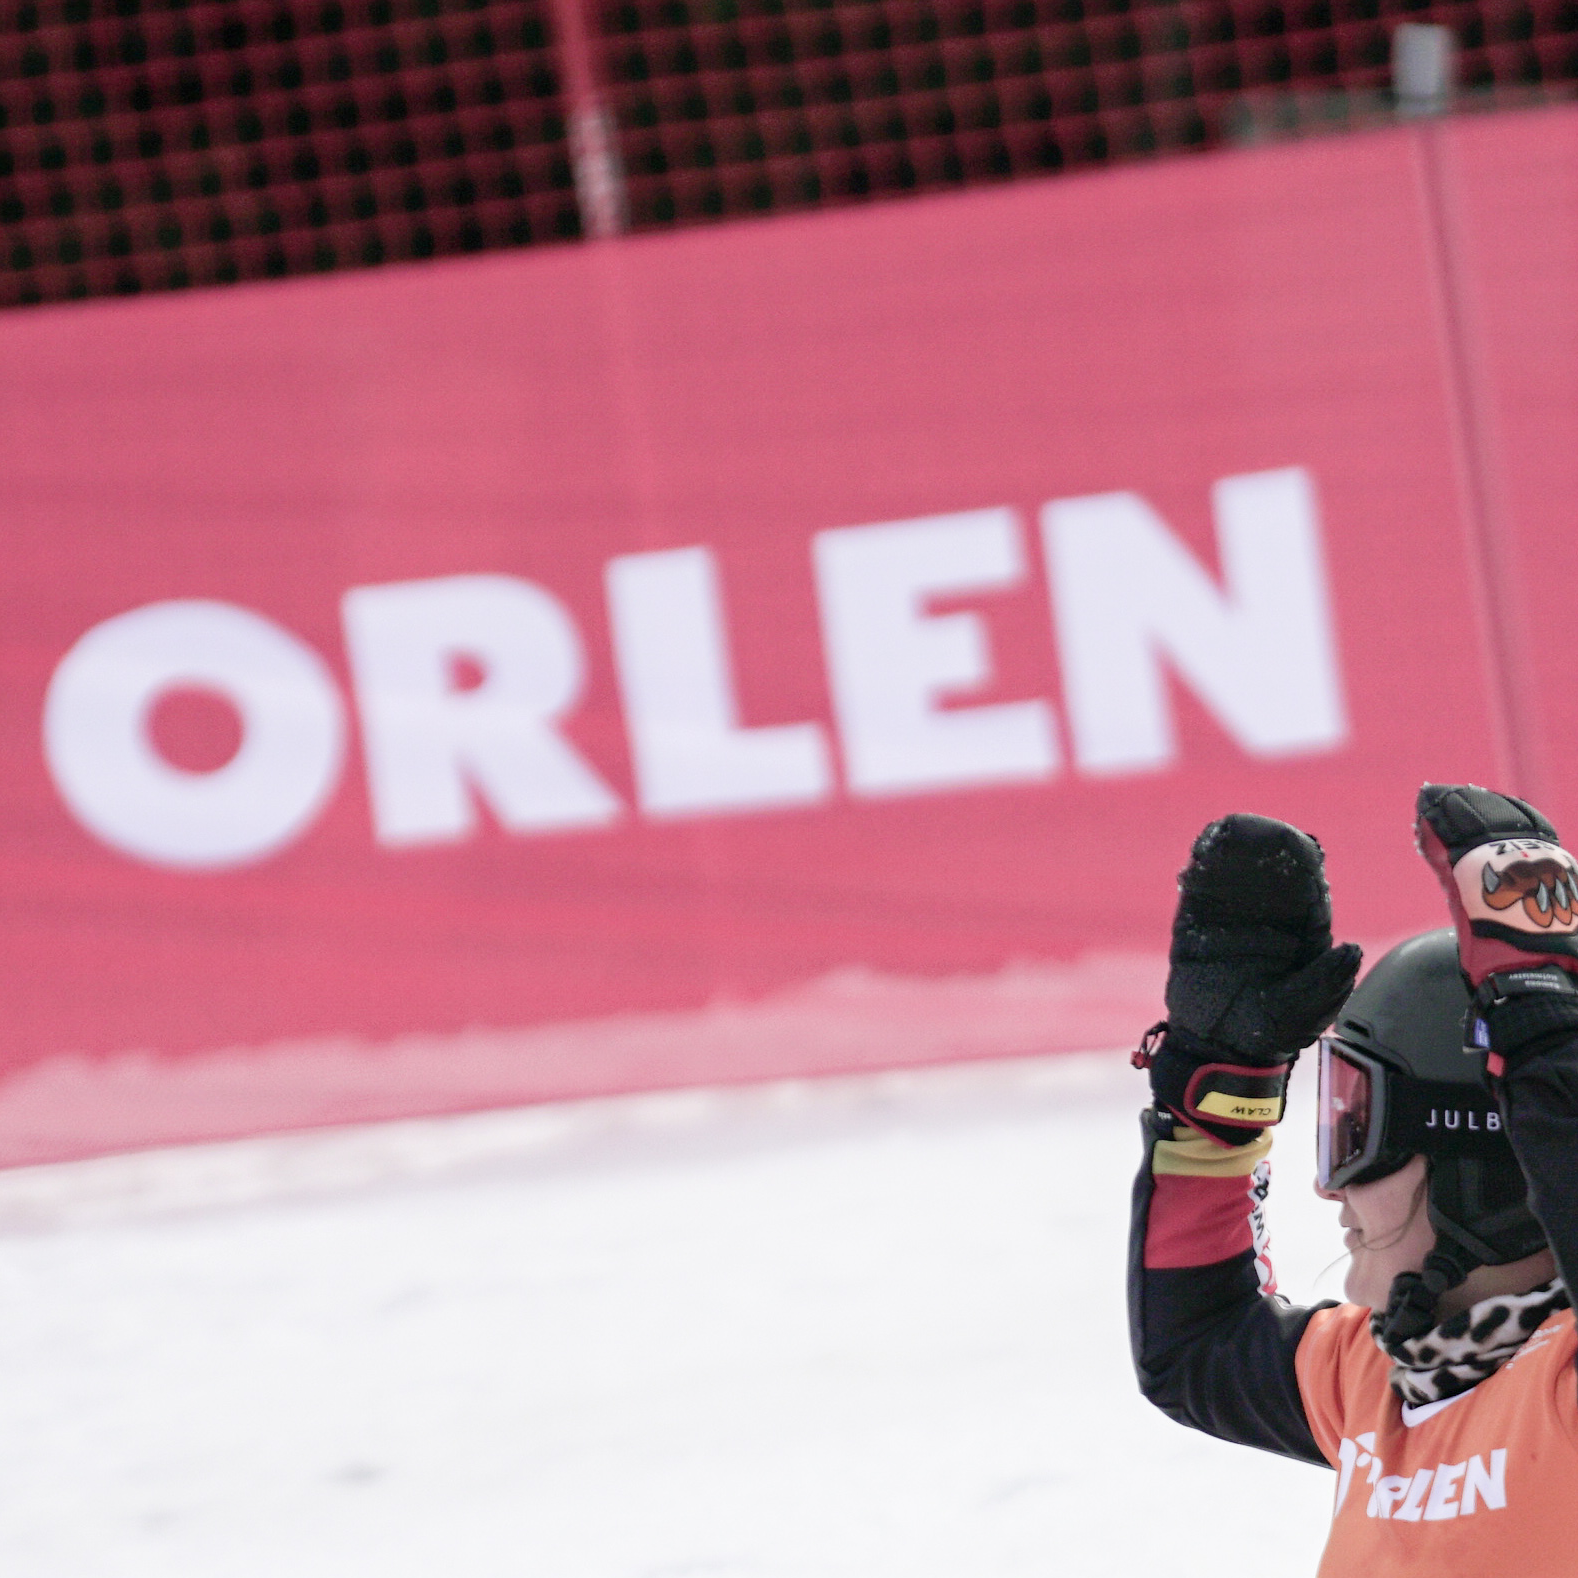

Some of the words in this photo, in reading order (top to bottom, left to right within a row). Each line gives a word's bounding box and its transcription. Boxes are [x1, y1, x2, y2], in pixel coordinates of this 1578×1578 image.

[41, 464, 1349, 870] ORLEN
[1231, 1105, 1271, 1116] CLAW
[1424, 1108, 1502, 1131] JULB
